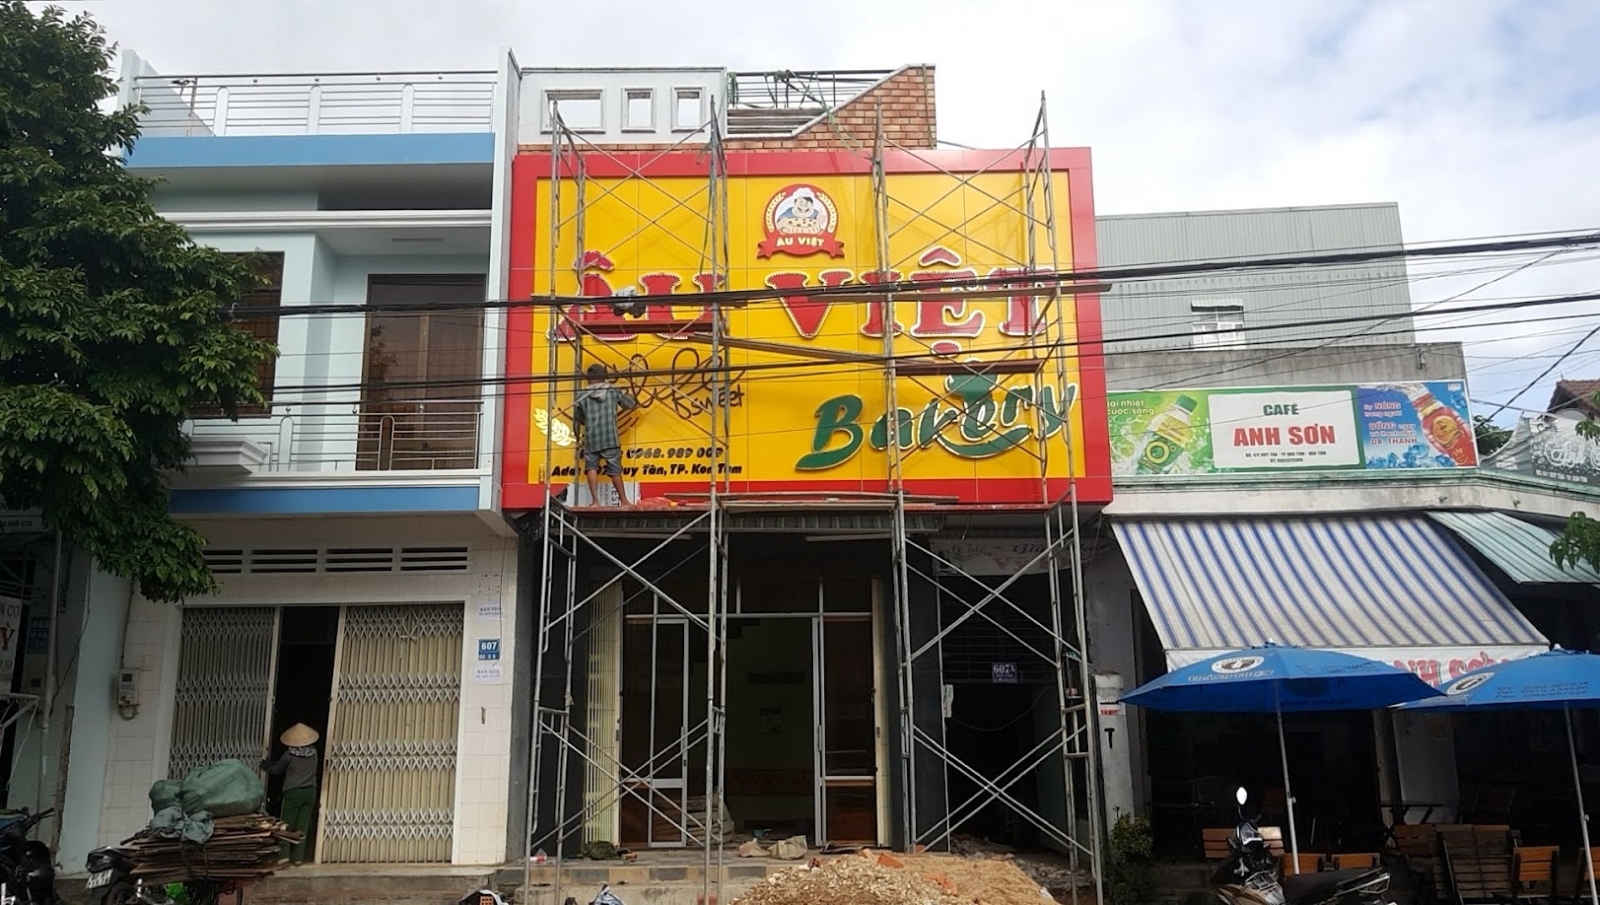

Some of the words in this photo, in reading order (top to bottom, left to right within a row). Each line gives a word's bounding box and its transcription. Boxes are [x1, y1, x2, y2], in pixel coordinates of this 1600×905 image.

[797, 236, 825, 248] VIỆT
[765, 246, 1059, 358] VIỆT
[1262, 402, 1299, 416] CAFÉ
[1233, 427, 1281, 446] ANH
[1288, 423, 1336, 445] SƠN
[1388, 437, 1418, 445] THANH
[669, 463, 689, 475] TP.
[481, 641, 498, 651] 607
